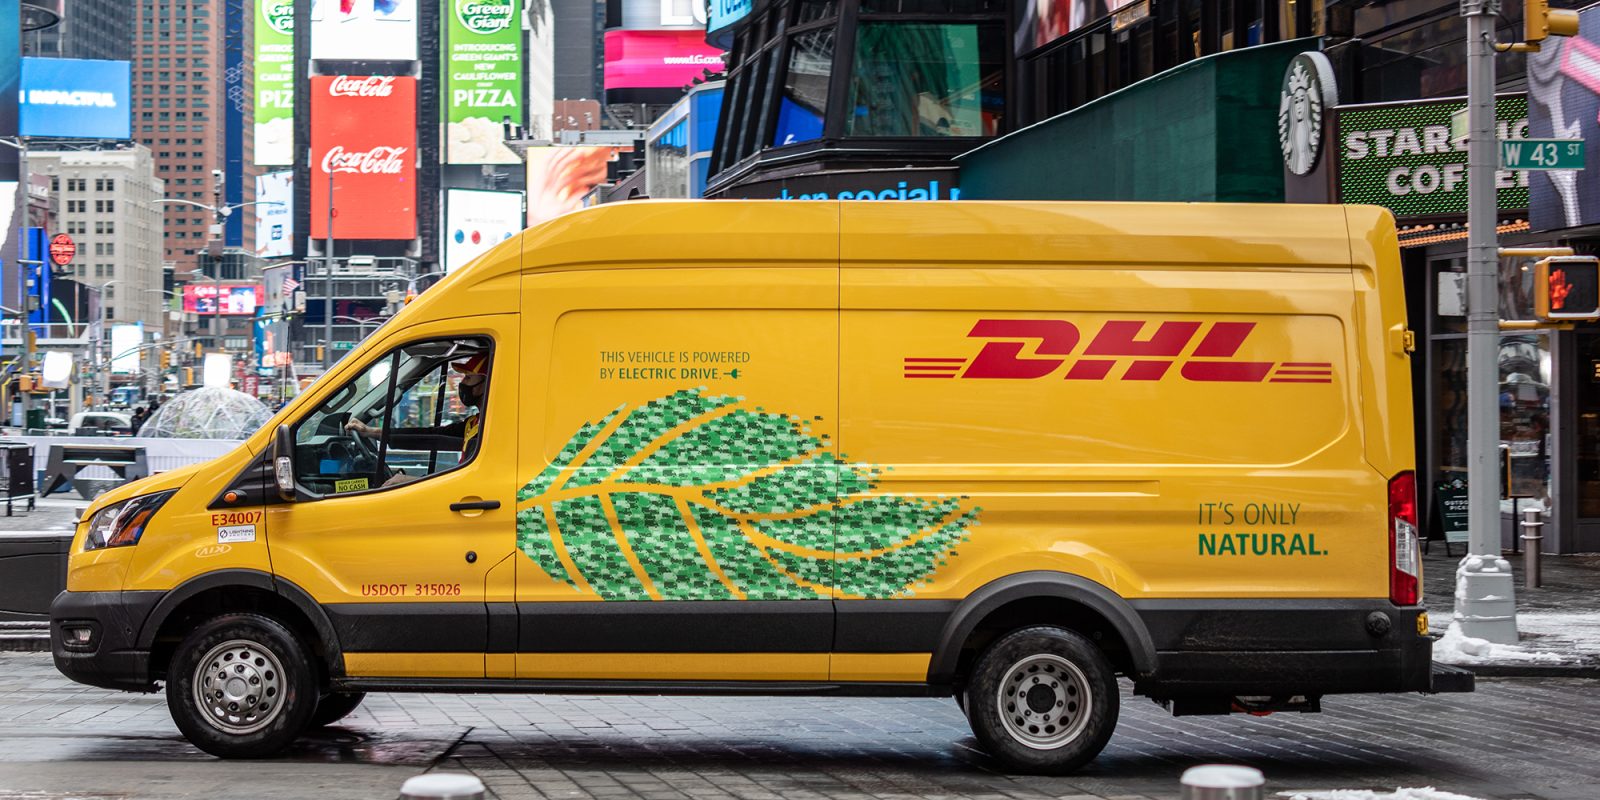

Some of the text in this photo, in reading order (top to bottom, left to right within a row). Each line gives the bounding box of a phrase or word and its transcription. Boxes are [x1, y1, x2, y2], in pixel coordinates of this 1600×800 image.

[463, 2, 510, 15] Green
[469, 15, 512, 28] Giant
[329, 75, 396, 96] Coca-Cola
[260, 90, 294, 108] PIZ
[453, 89, 517, 107] PIZZA
[321, 146, 408, 173] Coca-Cola
[1505, 143, 1581, 166] W 43 ST
[600, 351, 750, 363] THIS VEHICLE IS POWERED
[961, 319, 1275, 383] DHL
[600, 368, 722, 381] BY ELECTRIC DRIVE.
[211, 511, 262, 526] E34007
[1198, 502, 1301, 525] IT'S ONLY
[1198, 533, 1329, 556] NATURAL.
[362, 584, 461, 596] USDOT 315026
